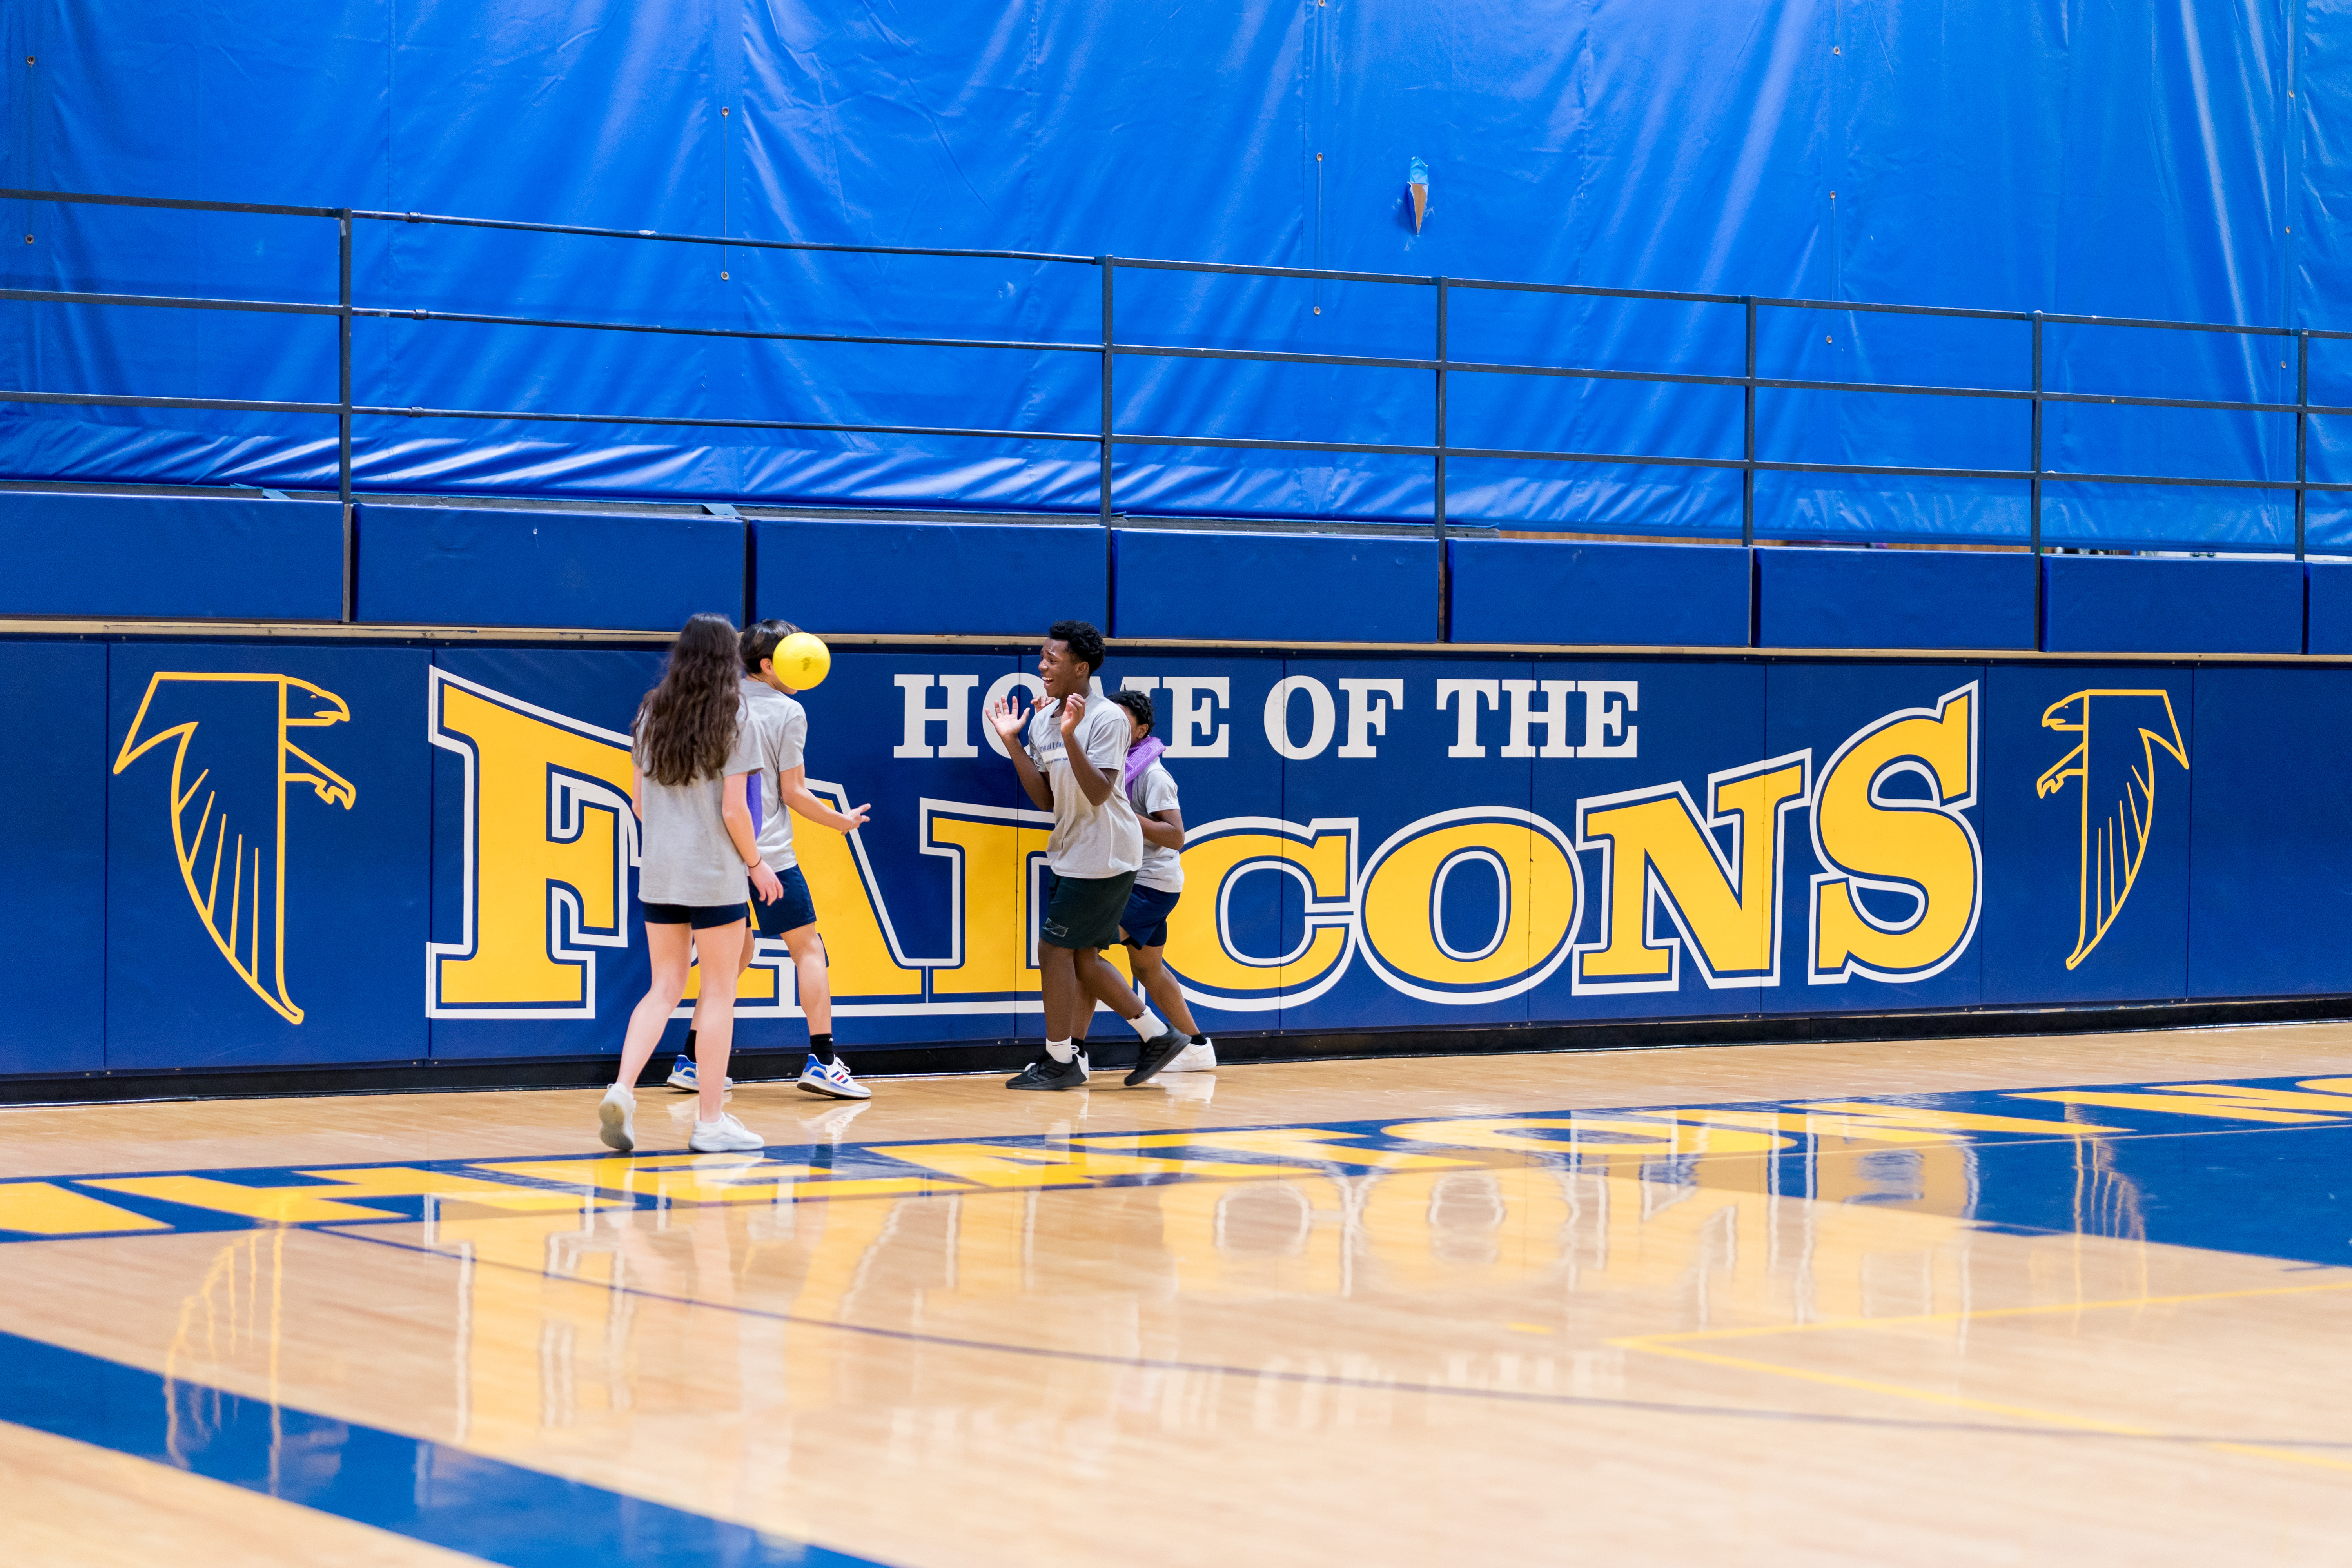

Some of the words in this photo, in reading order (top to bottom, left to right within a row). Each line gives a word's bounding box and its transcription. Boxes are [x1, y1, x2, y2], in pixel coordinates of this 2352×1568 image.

[1264, 676, 1403, 759] OF
[1437, 679, 1638, 758] THE
[1998, 1078, 2352, 1123] N
